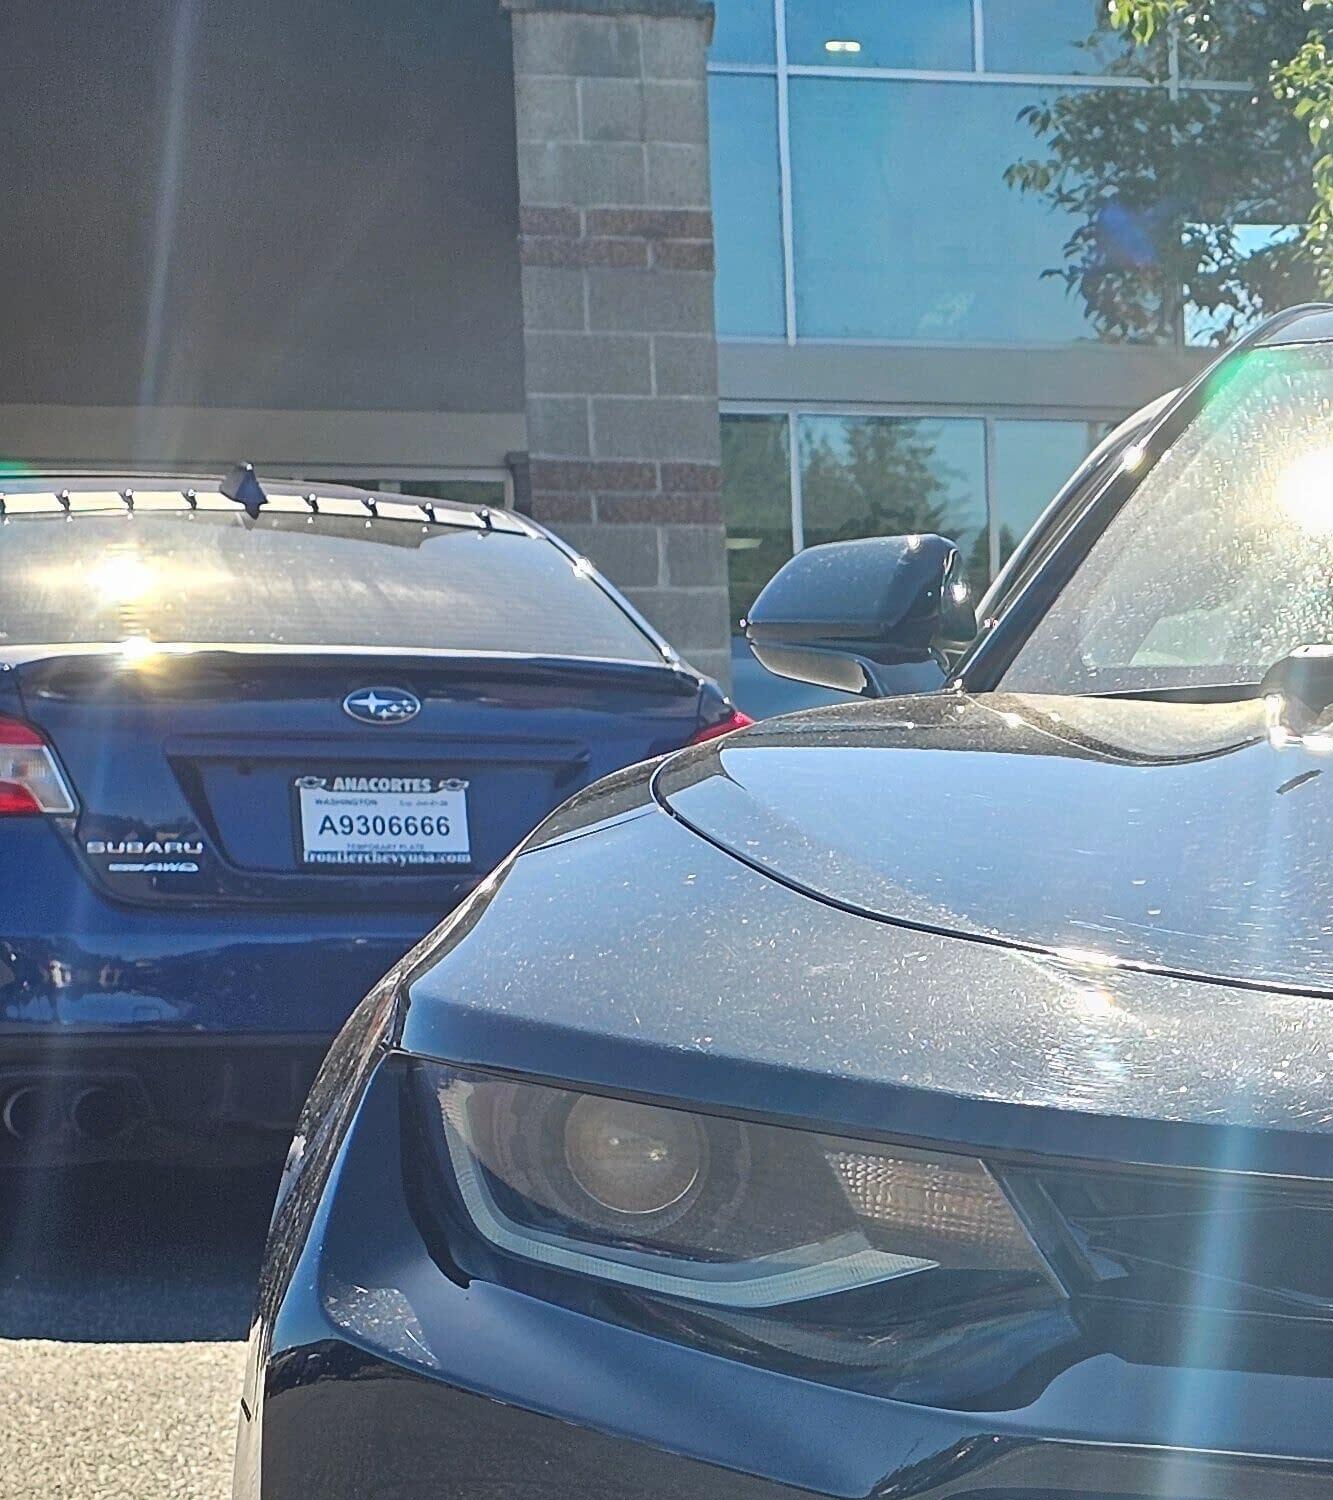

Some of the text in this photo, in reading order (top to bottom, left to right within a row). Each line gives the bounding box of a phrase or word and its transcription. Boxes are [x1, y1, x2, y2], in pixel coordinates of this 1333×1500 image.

[333, 777, 431, 793] ANACORTES
[318, 815, 450, 836] A9306666
[87, 841, 203, 854] SUBARU
